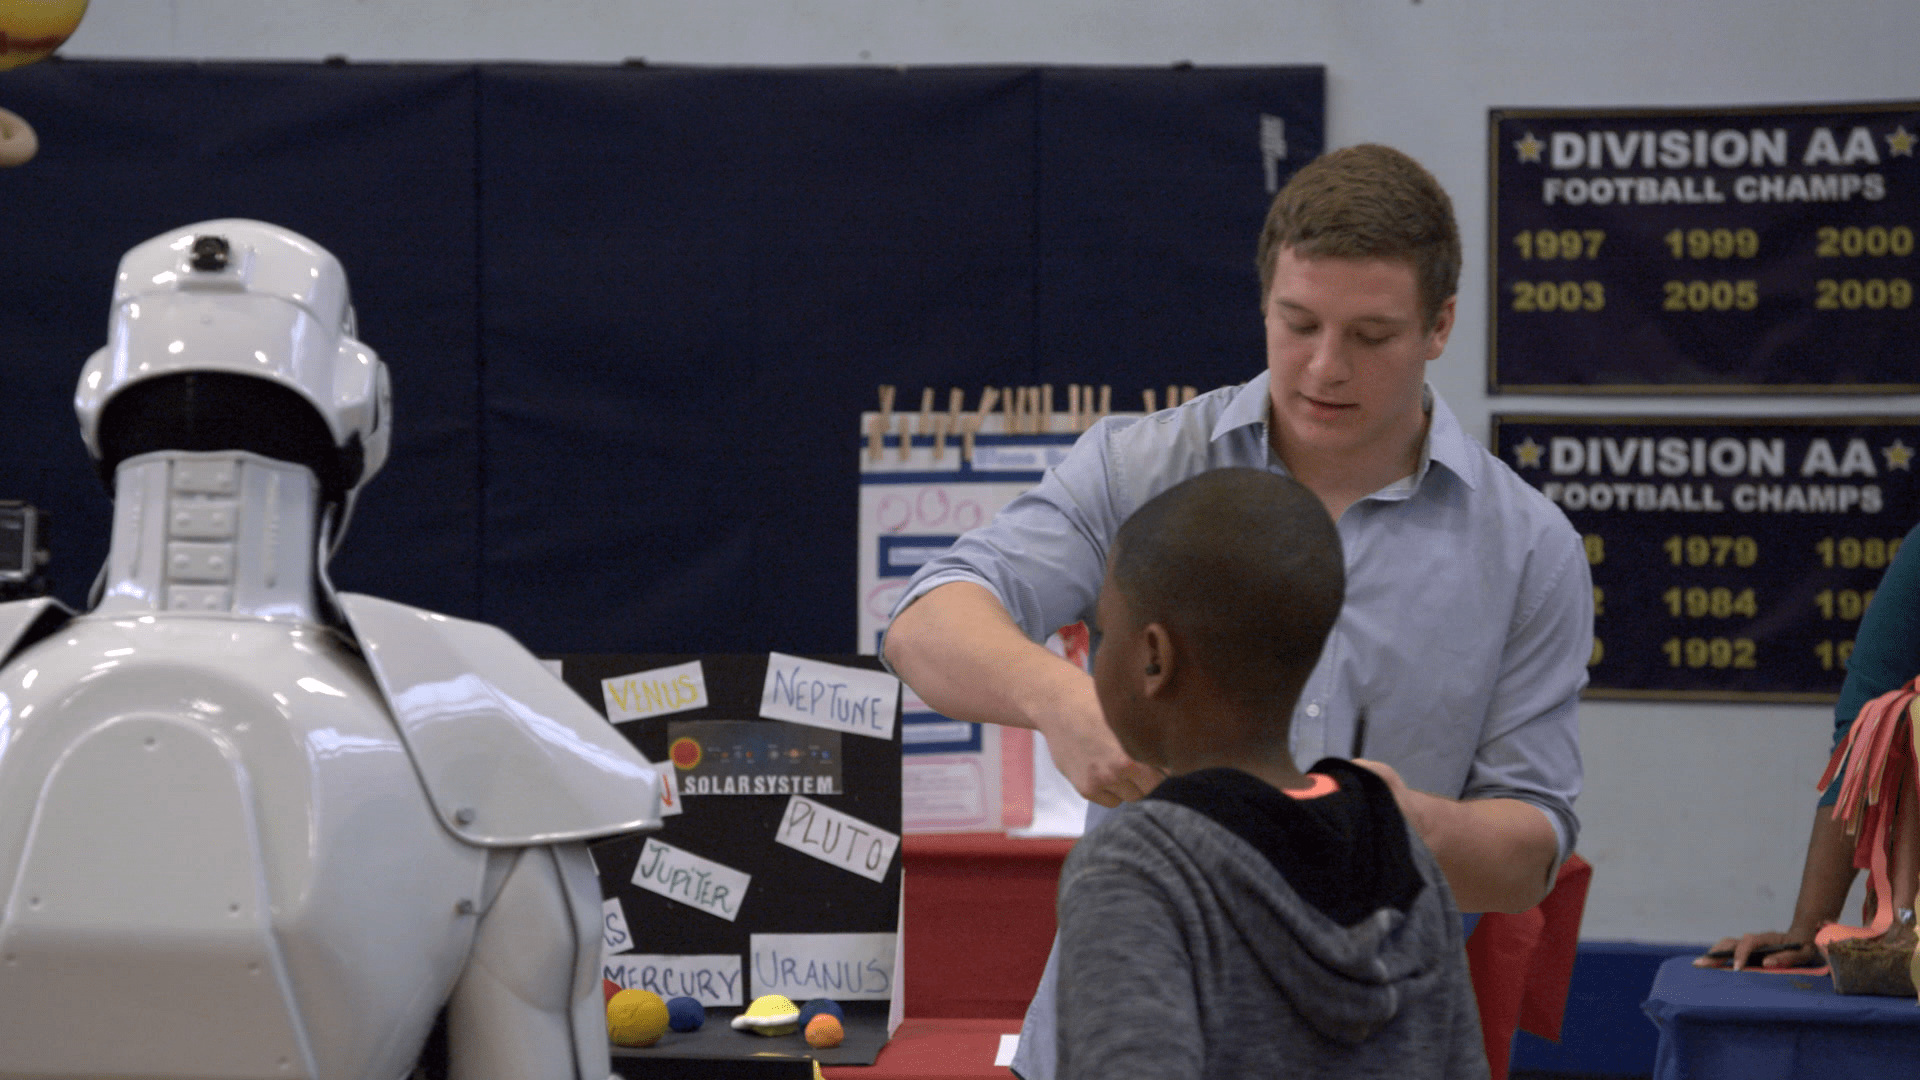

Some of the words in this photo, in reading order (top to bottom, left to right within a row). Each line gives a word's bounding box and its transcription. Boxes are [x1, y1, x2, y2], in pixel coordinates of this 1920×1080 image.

[1551, 129, 1788, 168] DIVISION
[1803, 127, 1880, 165] AA
[1543, 176, 1725, 204] FOOTBALL
[1734, 174, 1886, 202] CHAMPS
[1514, 229, 1605, 260] 1997
[1665, 229, 1759, 259] 1999
[1816, 226, 1914, 257] 2000
[1513, 281, 1605, 312] 2003
[1664, 281, 1759, 311] 2005
[1815, 279, 1912, 310] 2009
[1551, 437, 1785, 476] DIVISION
[1801, 438, 1878, 476] AA
[1543, 483, 1723, 512] FOOTBALL
[1732, 484, 1883, 513] CHAMPS
[1664, 536, 1758, 566] 1979
[1664, 587, 1757, 617] 1984
[1663, 638, 1757, 668] 1992
[773, 665, 884, 731] NEPTUNE
[786, 799, 884, 872] PLUTO
[602, 964, 741, 1000] MERCURY
[754, 950, 890, 994] URANUS
